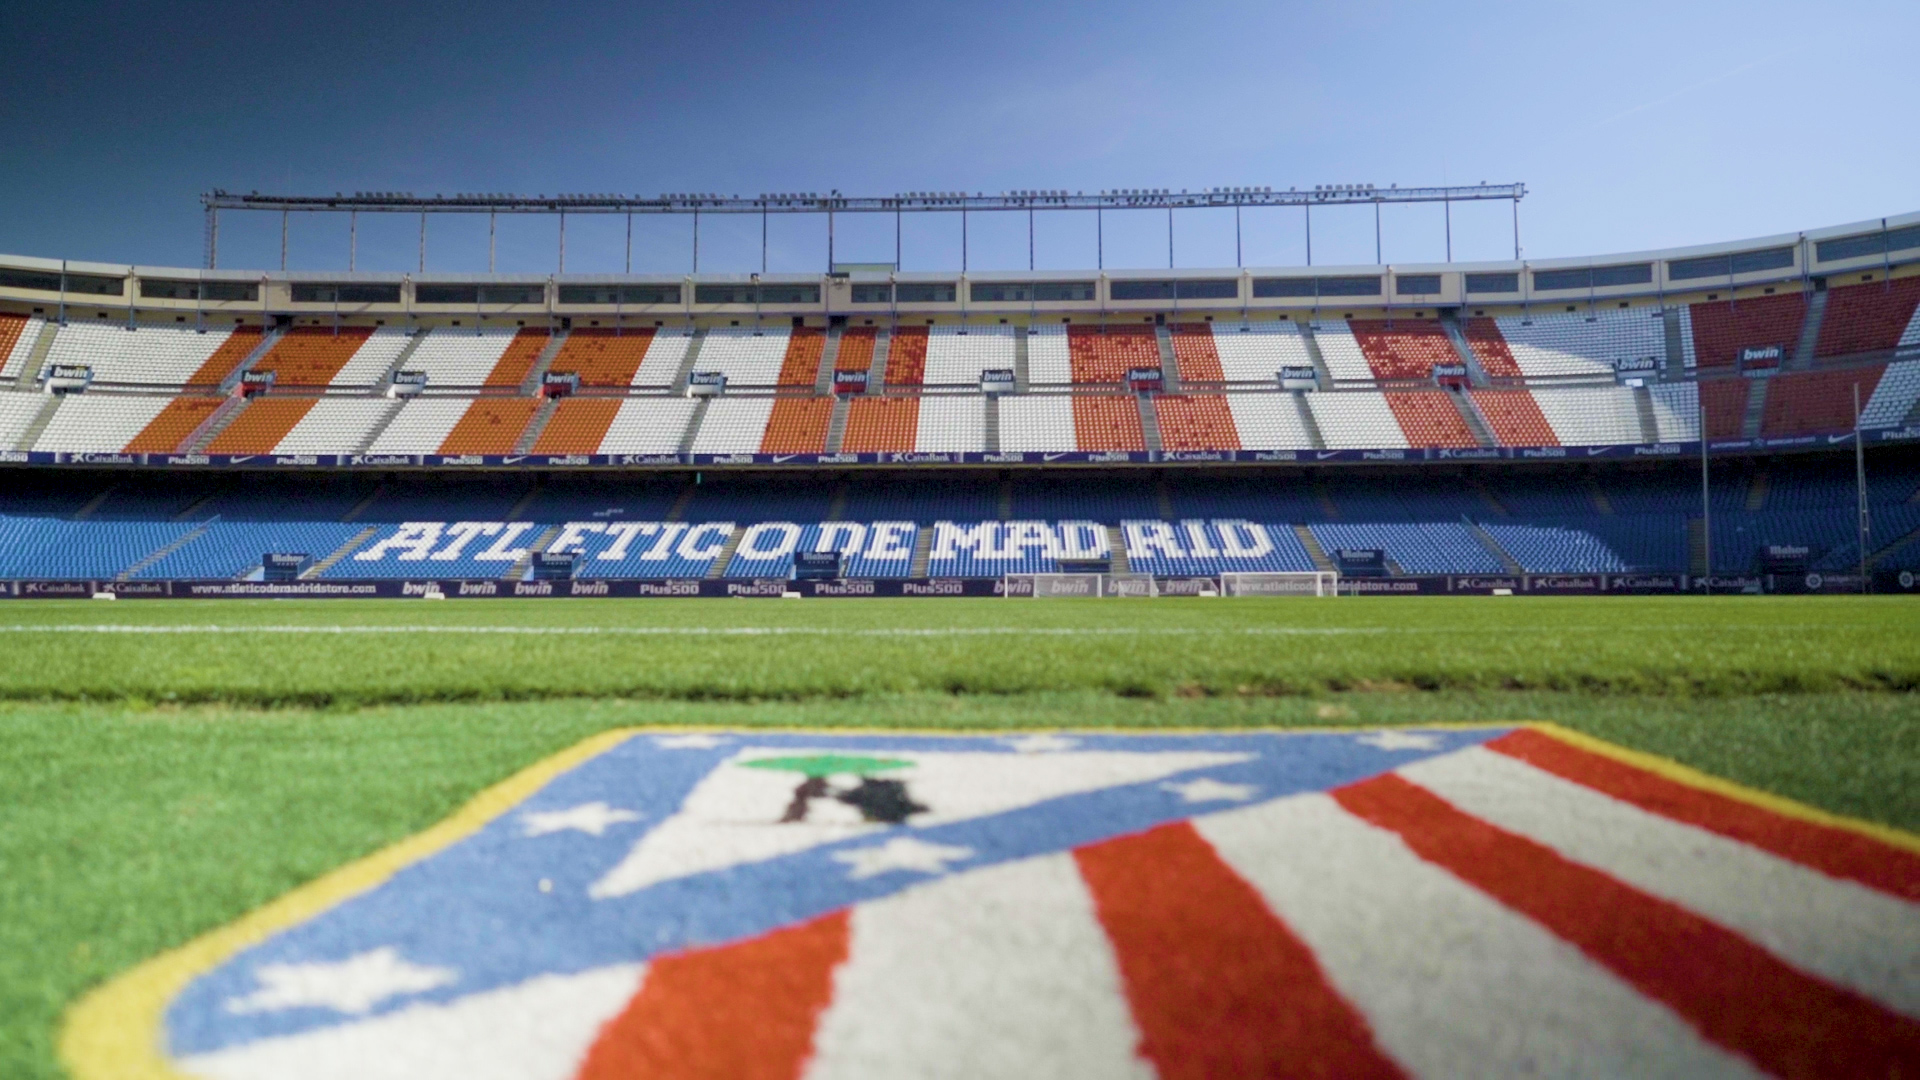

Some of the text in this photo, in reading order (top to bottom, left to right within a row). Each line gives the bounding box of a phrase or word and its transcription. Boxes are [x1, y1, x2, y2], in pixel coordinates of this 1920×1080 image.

[1744, 347, 1779, 360] bwin
[1619, 358, 1654, 370] bwin
[54, 366, 88, 378] bwin
[1131, 370, 1159, 380] bwin
[1283, 368, 1313, 378] bwin
[1437, 365, 1466, 376] bwin
[244, 371, 273, 382] bwin
[396, 371, 424, 383] bwin
[546, 372, 575, 383] bwin
[692, 372, 720, 383] bwin
[837, 371, 865, 382] bwin
[983, 371, 1011, 381] bwin
[1363, 451, 1404, 459] Plus500
[1452, 449, 1500, 458] CaixaBank
[1523, 448, 1566, 457] Plus500
[1635, 446, 1680, 455] Plus500
[85, 454, 133, 463] CaixaBank
[168, 456, 210, 464] Plus500
[277, 456, 317, 464] Plus500
[364, 456, 410, 464] CaixaBank
[443, 456, 483, 464] Plus500
[549, 456, 589, 464] Plus500
[636, 456, 681, 464] CaixaBank
[713, 455, 753, 463] Plus500
[818, 455, 858, 463] Plus500
[905, 454, 950, 462] CaixaBank
[983, 454, 1023, 462] Plus500
[1089, 454, 1129, 462] Plus500
[1176, 452, 1222, 461] CaixaBank
[1256, 452, 1296, 460] Plus500
[815, 520, 918, 559] DE
[929, 520, 1275, 559] MADRID
[272, 554, 304, 562] Mahou
[542, 552, 573, 561] Mahou
[803, 552, 834, 561] Mahou
[1342, 549, 1374, 558] Mahou
[1051, 580, 1089, 593] bwin
[1108, 580, 1146, 593] bwin
[1166, 579, 1204, 593] bwin
[1471, 578, 1517, 588] CaixaBank
[1548, 578, 1595, 587] CaixaBank
[1626, 577, 1675, 587] CaixaBank
[1710, 576, 1762, 587] CaixaBank
[39, 583, 85, 593] CaixaBank
[116, 583, 162, 593] CaixaBank
[192, 583, 377, 593] www.atleticodemadridstore.com
[402, 581, 441, 594] bwin
[459, 581, 497, 594] bwin
[515, 582, 553, 594] bwin
[571, 581, 609, 594] bwin
[640, 583, 700, 594] Plus500
[728, 583, 787, 594] Plus500
[815, 583, 874, 594] Plus500
[903, 583, 963, 594] Plus500
[993, 581, 1032, 593] bwin
